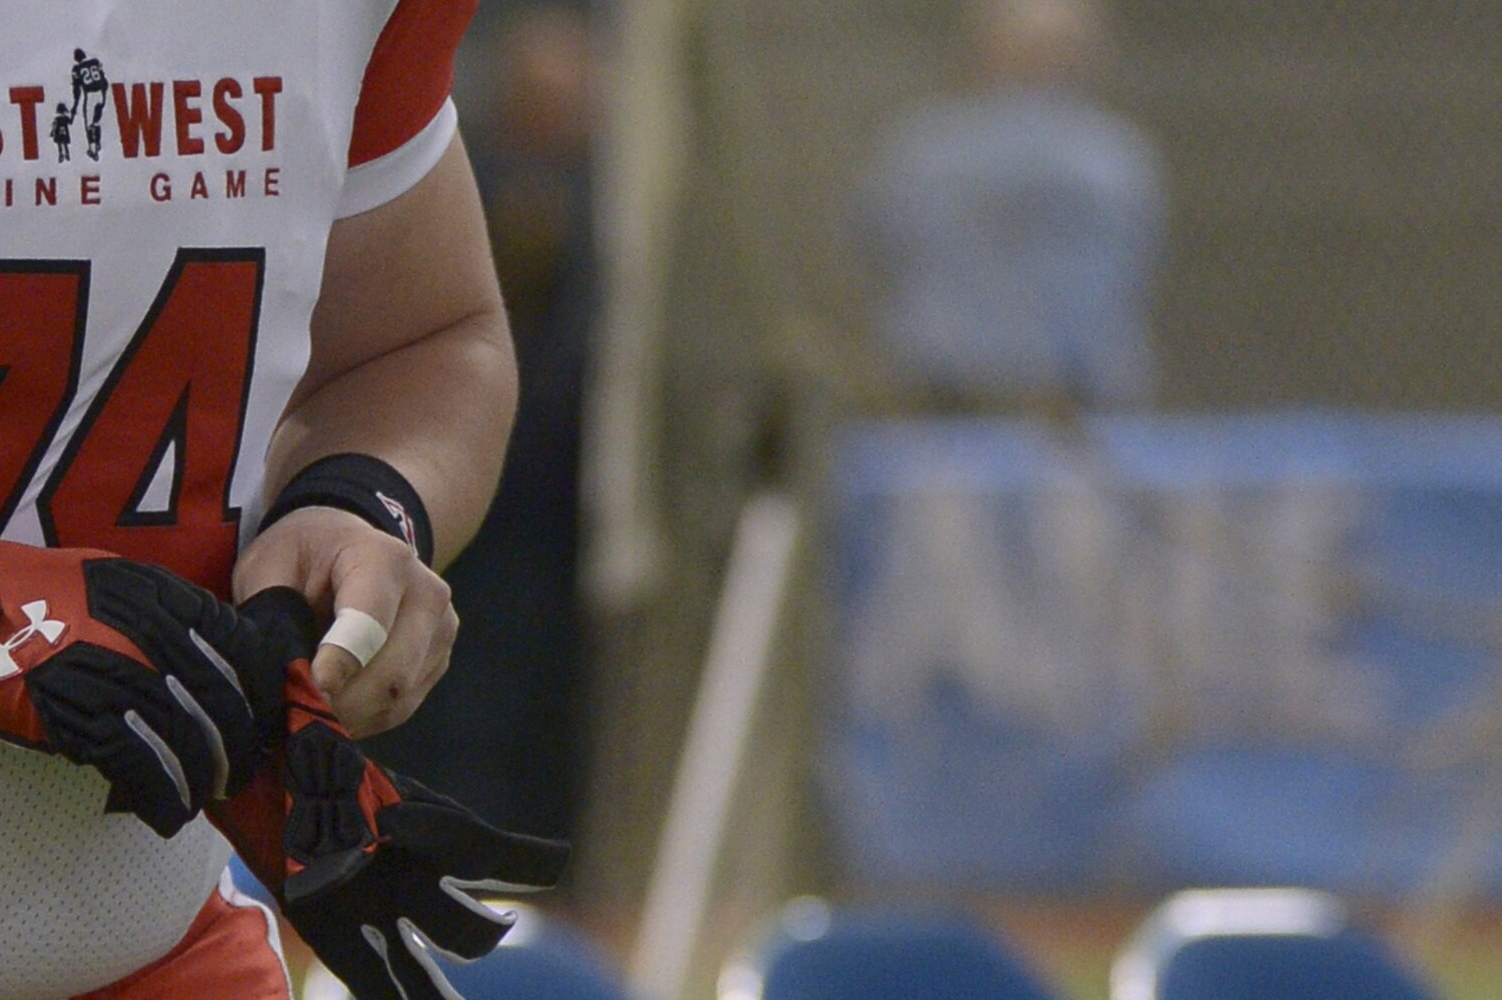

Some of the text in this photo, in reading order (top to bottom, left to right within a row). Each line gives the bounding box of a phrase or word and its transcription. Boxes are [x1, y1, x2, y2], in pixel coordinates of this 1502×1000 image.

[80, 65, 101, 85] 26
[111, 76, 283, 158] WEST
[150, 167, 280, 202] GAME
